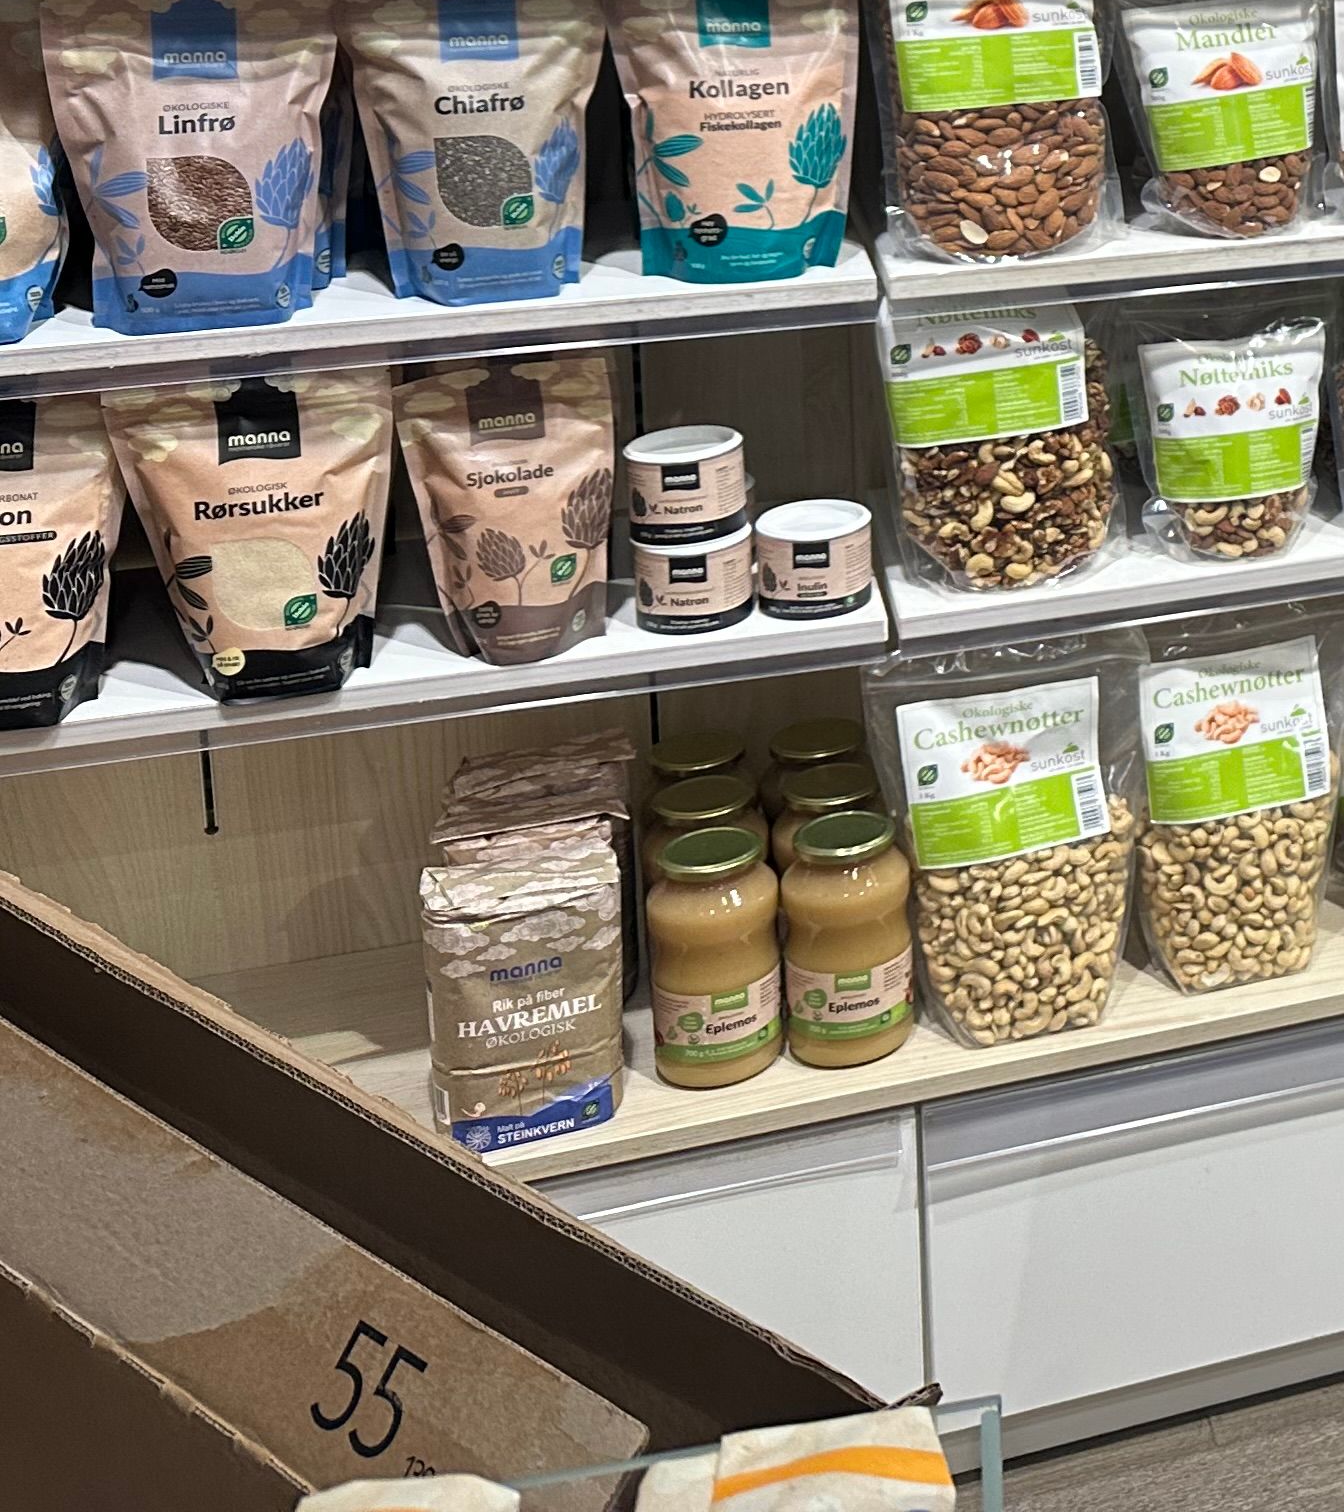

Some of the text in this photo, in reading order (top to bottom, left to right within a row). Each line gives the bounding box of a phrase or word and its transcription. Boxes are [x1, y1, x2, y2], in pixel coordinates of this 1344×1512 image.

[706, 20, 761, 34] manna
[1176, 22, 1278, 52] Mandler
[449, 33, 509, 48] manna
[163, 49, 227, 64] manna
[689, 79, 790, 100] Kollagen
[163, 101, 229, 112] ØKOLOGISKE
[434, 91, 525, 118] Chiafrø
[704, 109, 776, 122] HYDROLYSERT
[158, 113, 236, 136] Linfrø
[700, 118, 782, 132] Fiskekollagen
[478, 411, 536, 431] manna
[228, 430, 291, 447] manna
[467, 464, 554, 489] Sjokolade
[228, 482, 288, 496] ØKOLOGISK
[195, 490, 324, 522] Rørsukker
[663, 502, 704, 517] Natron
[670, 595, 710, 608] Natron
[1152, 666, 1305, 710] Cashewnøtter
[962, 700, 1035, 721] Økologiske
[912, 704, 1085, 752] Cashewnøtter
[1029, 749, 1086, 773] sunkost
[490, 955, 563, 982] manna
[492, 987, 566, 1014] Rik på fiber
[828, 995, 881, 1015] Eplemos
[457, 993, 603, 1039] HAVREMEL
[705, 1012, 758, 1037] Eplemos
[485, 1018, 577, 1050] ØKOLOGISK
[497, 1118, 575, 1145] STEINKVERN
[310, 1319, 429, 1458] 55
